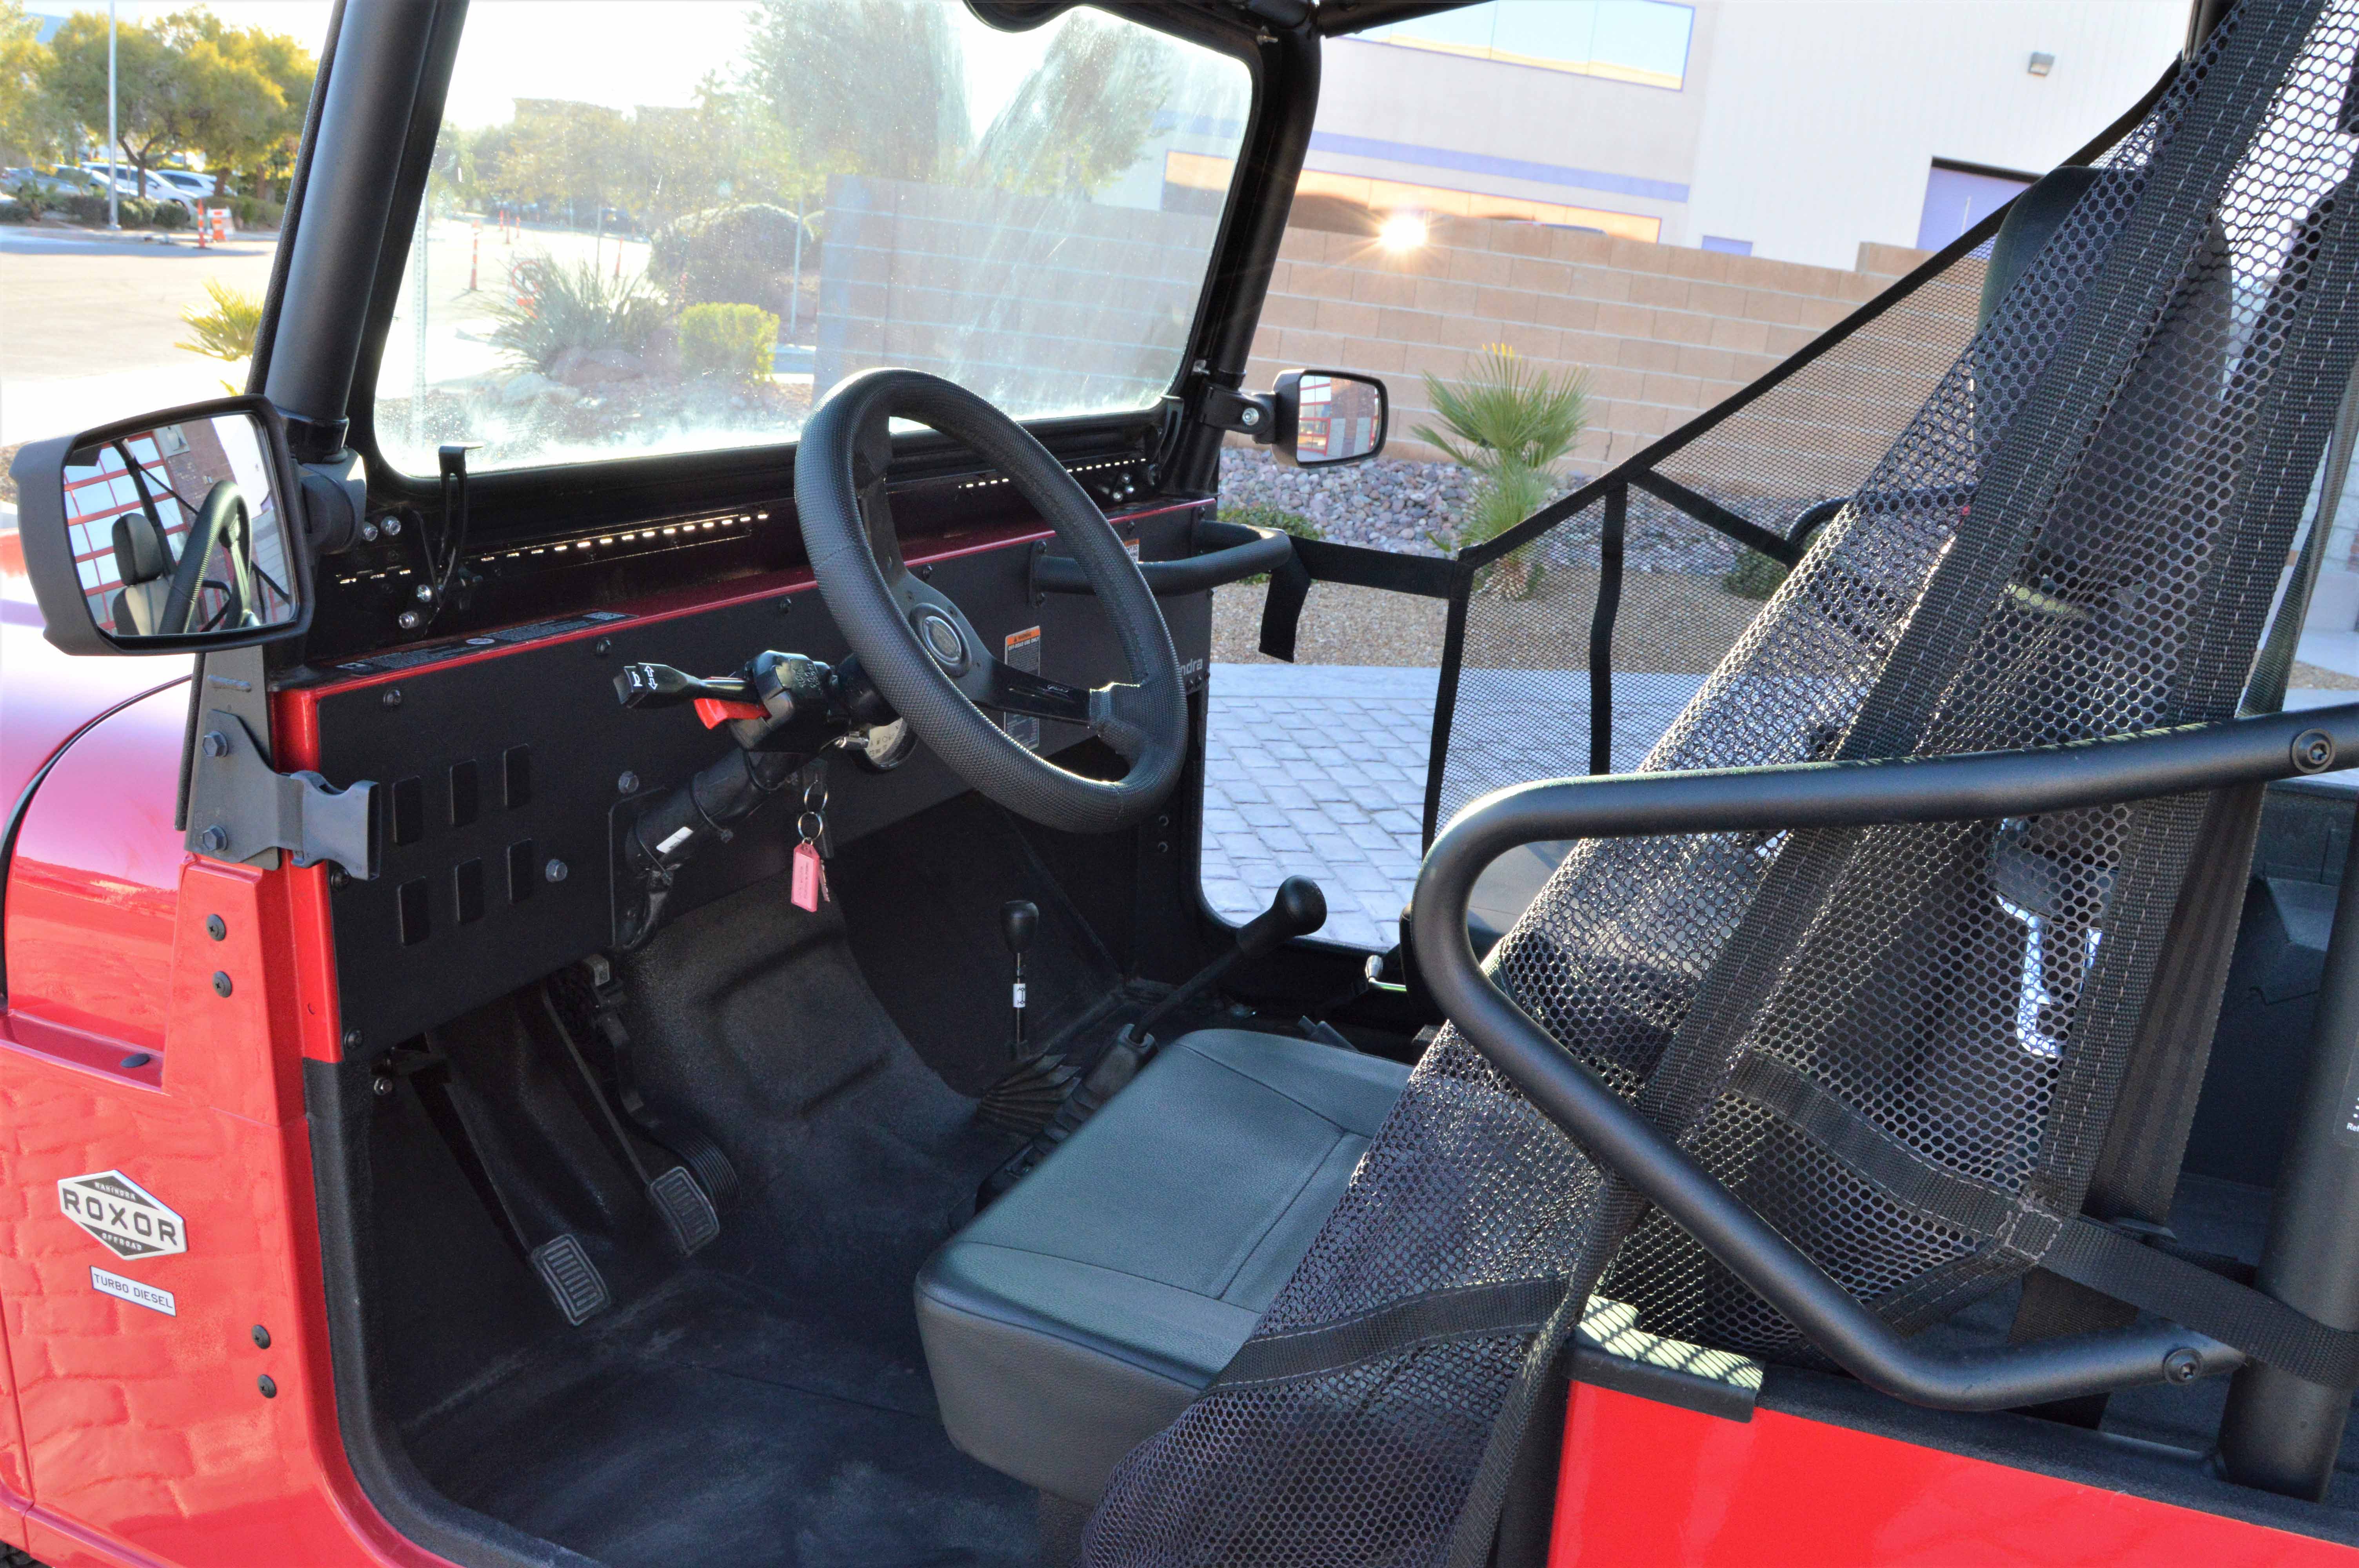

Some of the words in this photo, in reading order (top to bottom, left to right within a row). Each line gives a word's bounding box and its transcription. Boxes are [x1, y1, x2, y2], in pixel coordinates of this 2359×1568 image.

[1180, 658, 1203, 675] ndra
[2346, 1122, 2359, 1132] Ref
[94, 1181, 136, 1201] MAHINDRA
[63, 1187, 178, 1246] ROXOR
[94, 1273, 129, 1294] TURBO
[133, 1287, 173, 1308] DIESEL
